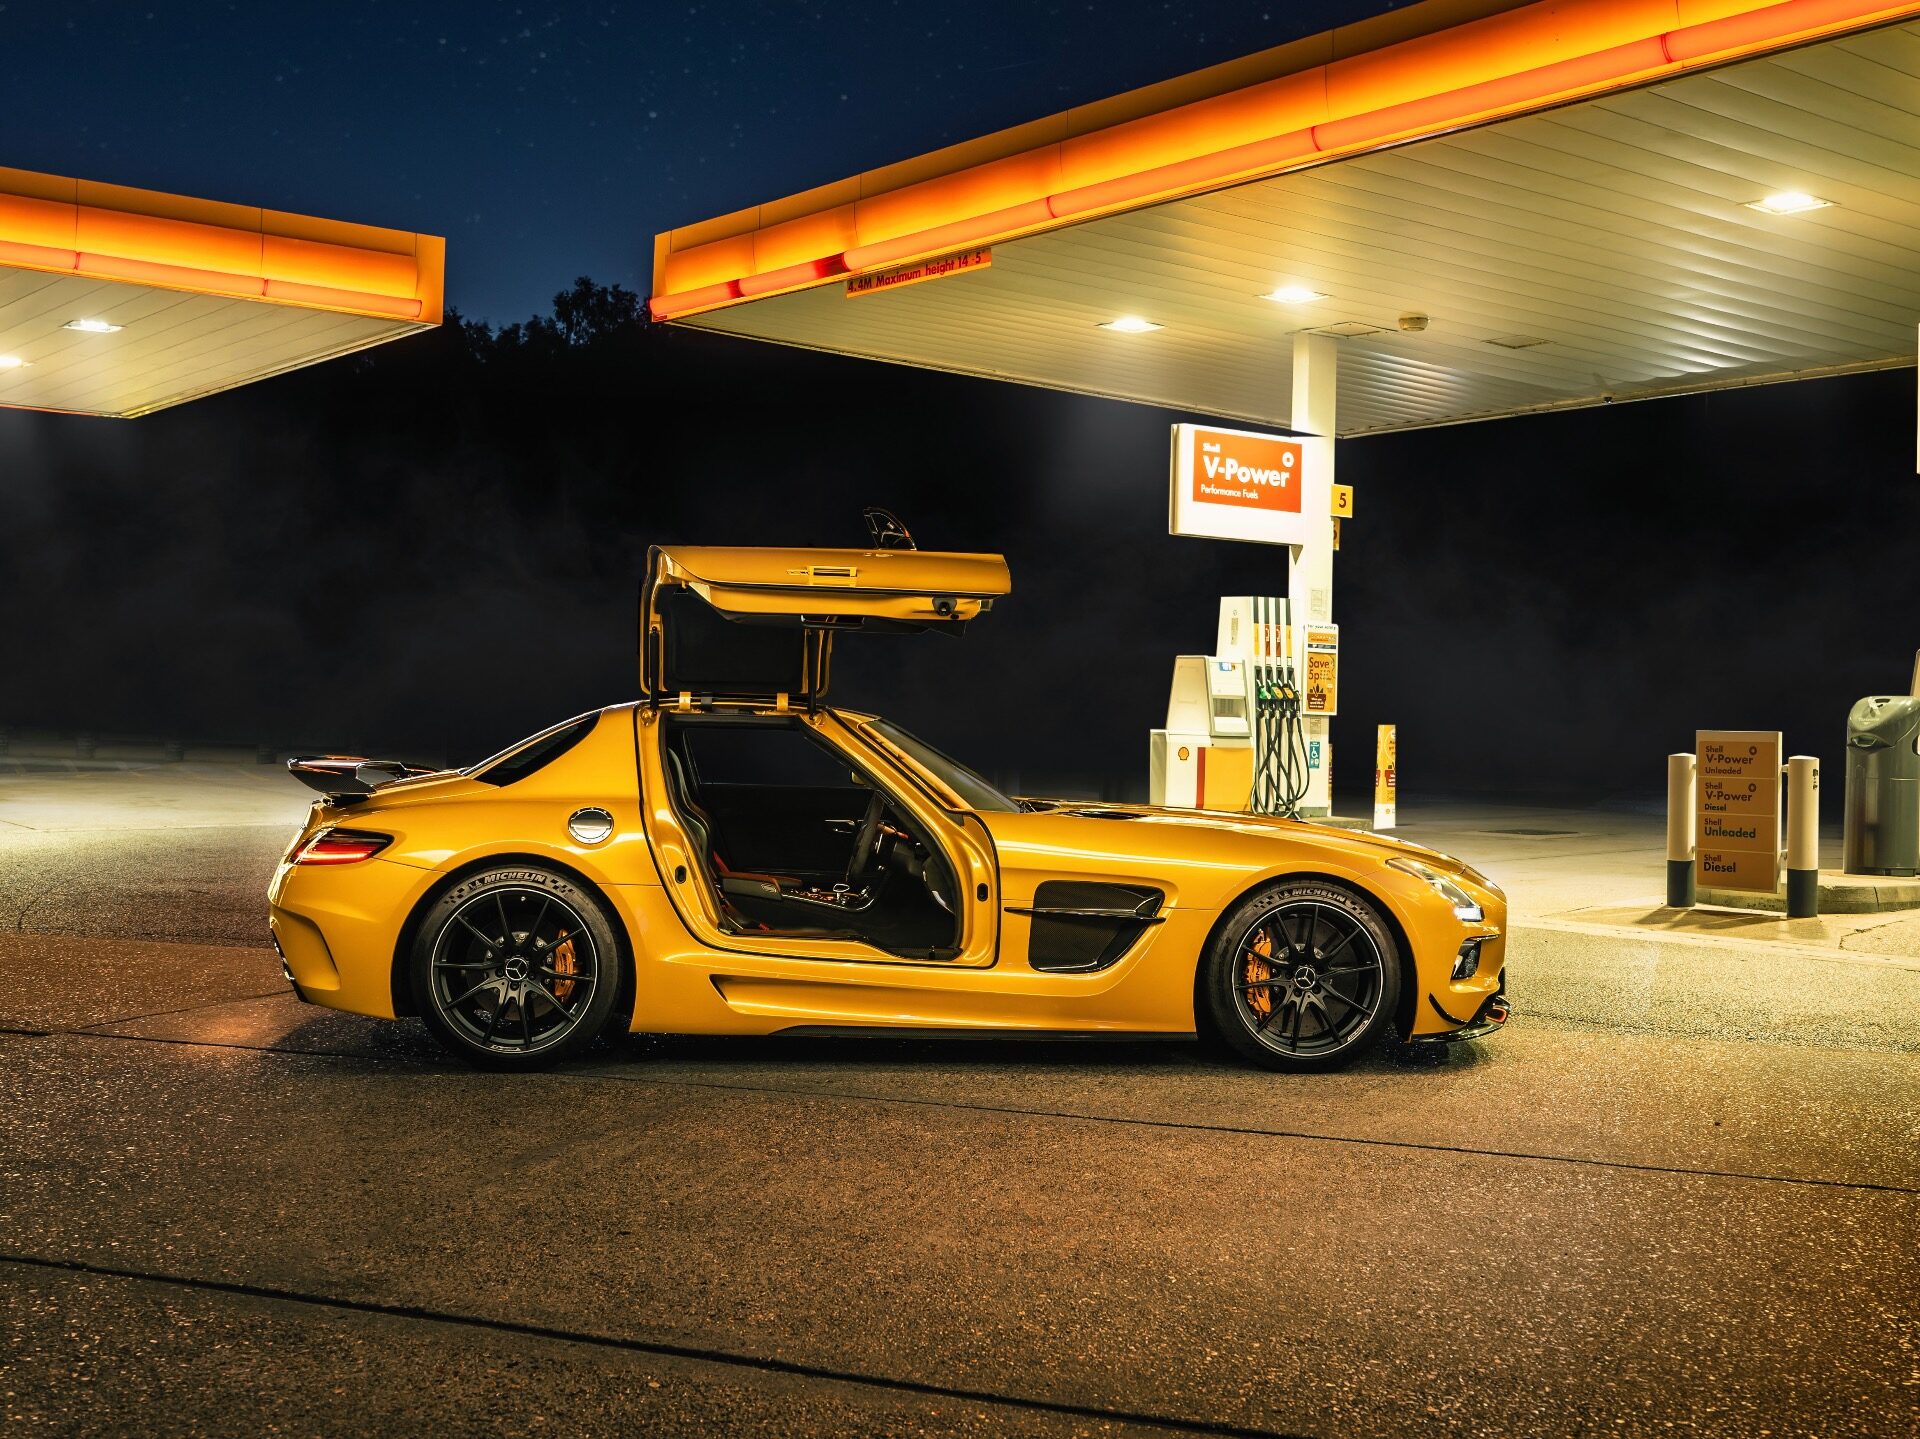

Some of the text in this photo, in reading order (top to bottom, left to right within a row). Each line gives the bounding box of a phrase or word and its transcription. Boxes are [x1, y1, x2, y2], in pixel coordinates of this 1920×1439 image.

[847, 278, 872, 293] 4.4M
[876, 269, 921, 287] Maximum
[925, 260, 955, 276] height
[1202, 442, 1221, 453] Shell
[1202, 455, 1290, 488] V-Power
[1200, 483, 1259, 500] Performance Fuels
[1338, 492, 1347, 509] 5
[1308, 656, 1330, 669] Save
[1308, 669, 1320, 684] 5p
[1705, 745, 1724, 753] Shell
[1705, 754, 1754, 765] V-Power
[1705, 767, 1742, 775] Unleaded
[1705, 782, 1723, 790] Shell
[1705, 790, 1753, 802] V-Power
[1704, 803, 1727, 812] Diesel
[1704, 818, 1722, 826] Shell
[1704, 826, 1756, 839] Unleaded
[1703, 854, 1722, 862] Shell
[1703, 861, 1737, 873] Diesel
[484, 872, 547, 885] MICHELIN
[1292, 888, 1347, 902] MICHELIN
